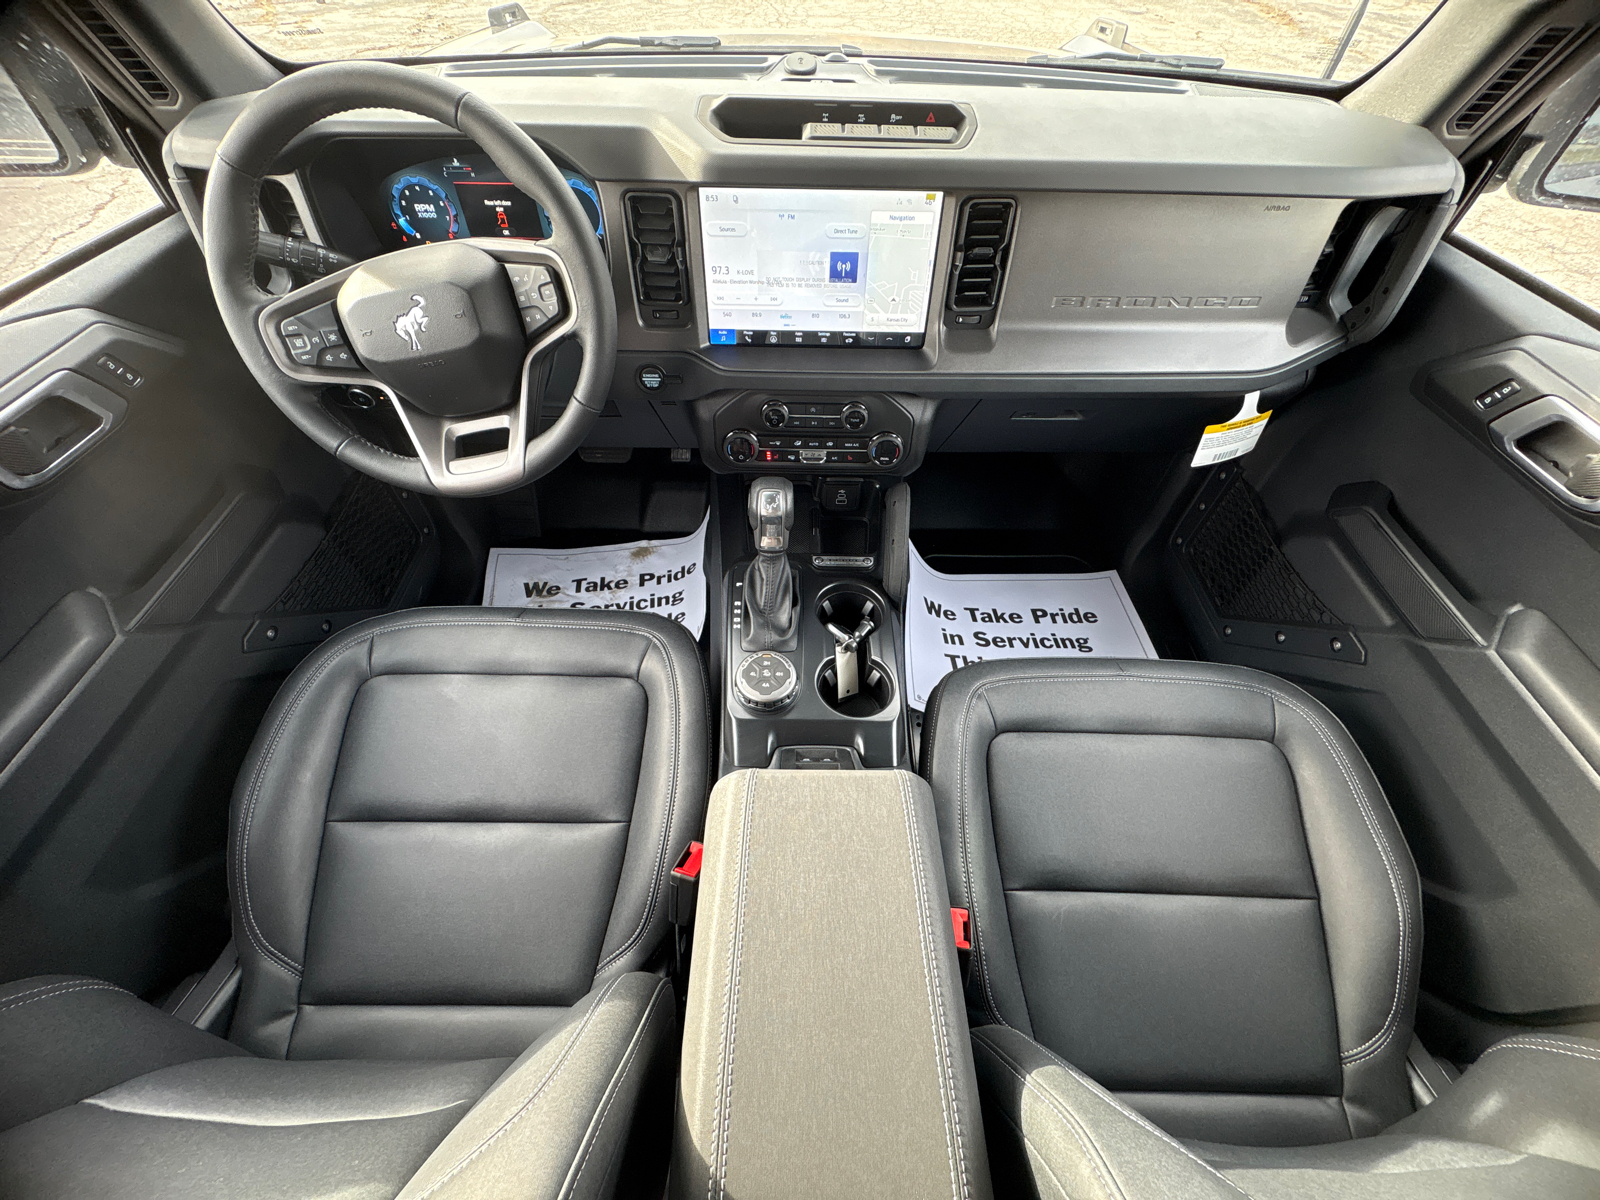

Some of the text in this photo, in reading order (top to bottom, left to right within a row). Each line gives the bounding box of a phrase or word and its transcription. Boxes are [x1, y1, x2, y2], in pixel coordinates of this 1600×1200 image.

[705, 194, 719, 202] 8:53
[414, 203, 435, 212] RPM
[1263, 204, 1291, 212] AIRBAG
[889, 214, 916, 222] Navigation
[711, 265, 730, 275] 97.3
[1051, 295, 1262, 309] BRONCO
[523, 562, 697, 598] We Take Pride
[923, 596, 1099, 624] We Take Pride
[941, 628, 1094, 653] in Servicing
